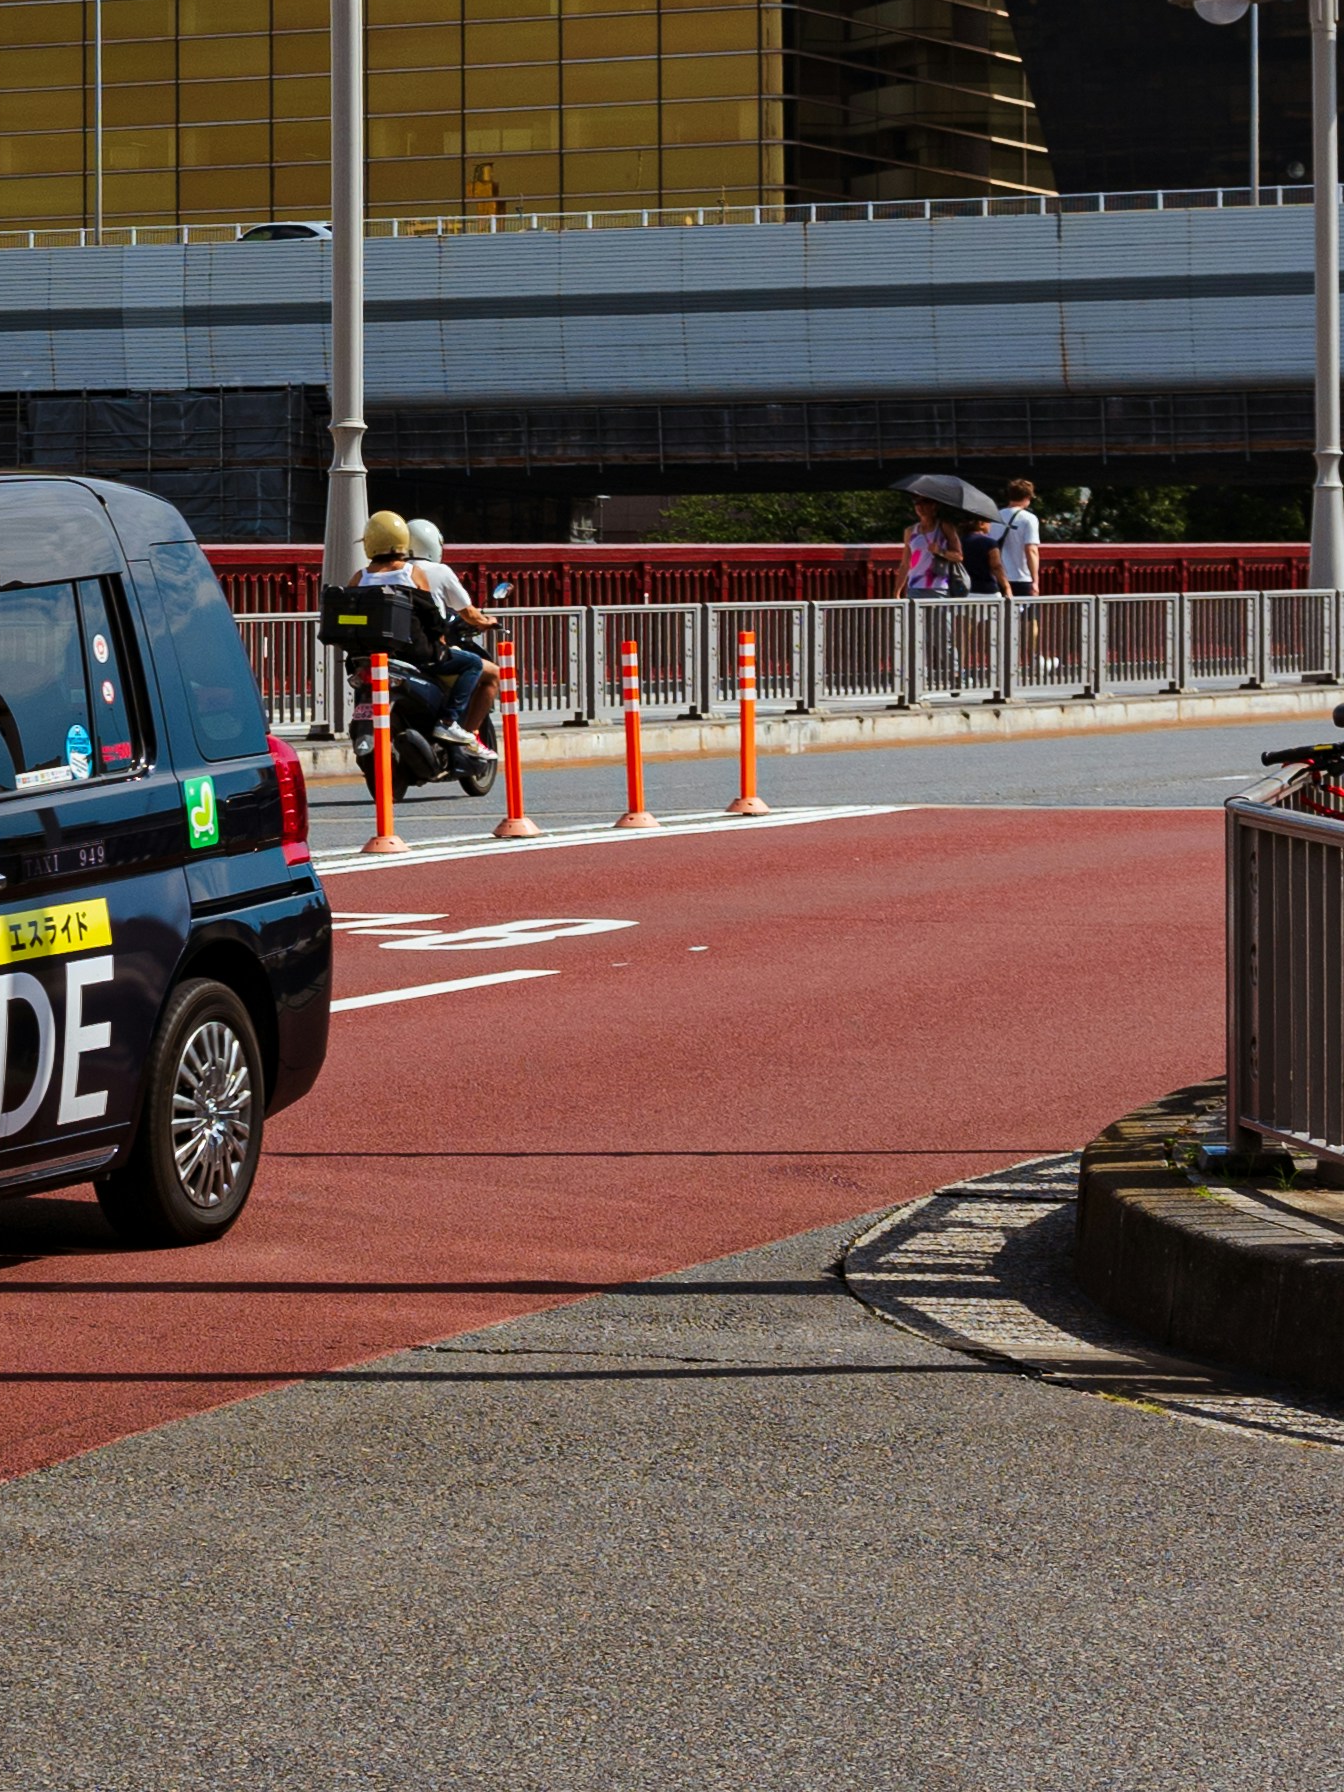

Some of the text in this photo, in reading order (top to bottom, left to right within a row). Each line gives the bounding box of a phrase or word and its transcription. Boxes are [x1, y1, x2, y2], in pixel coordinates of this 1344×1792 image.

[24, 845, 105, 877] TAXI 949
[9, 911, 89, 952] エスライド
